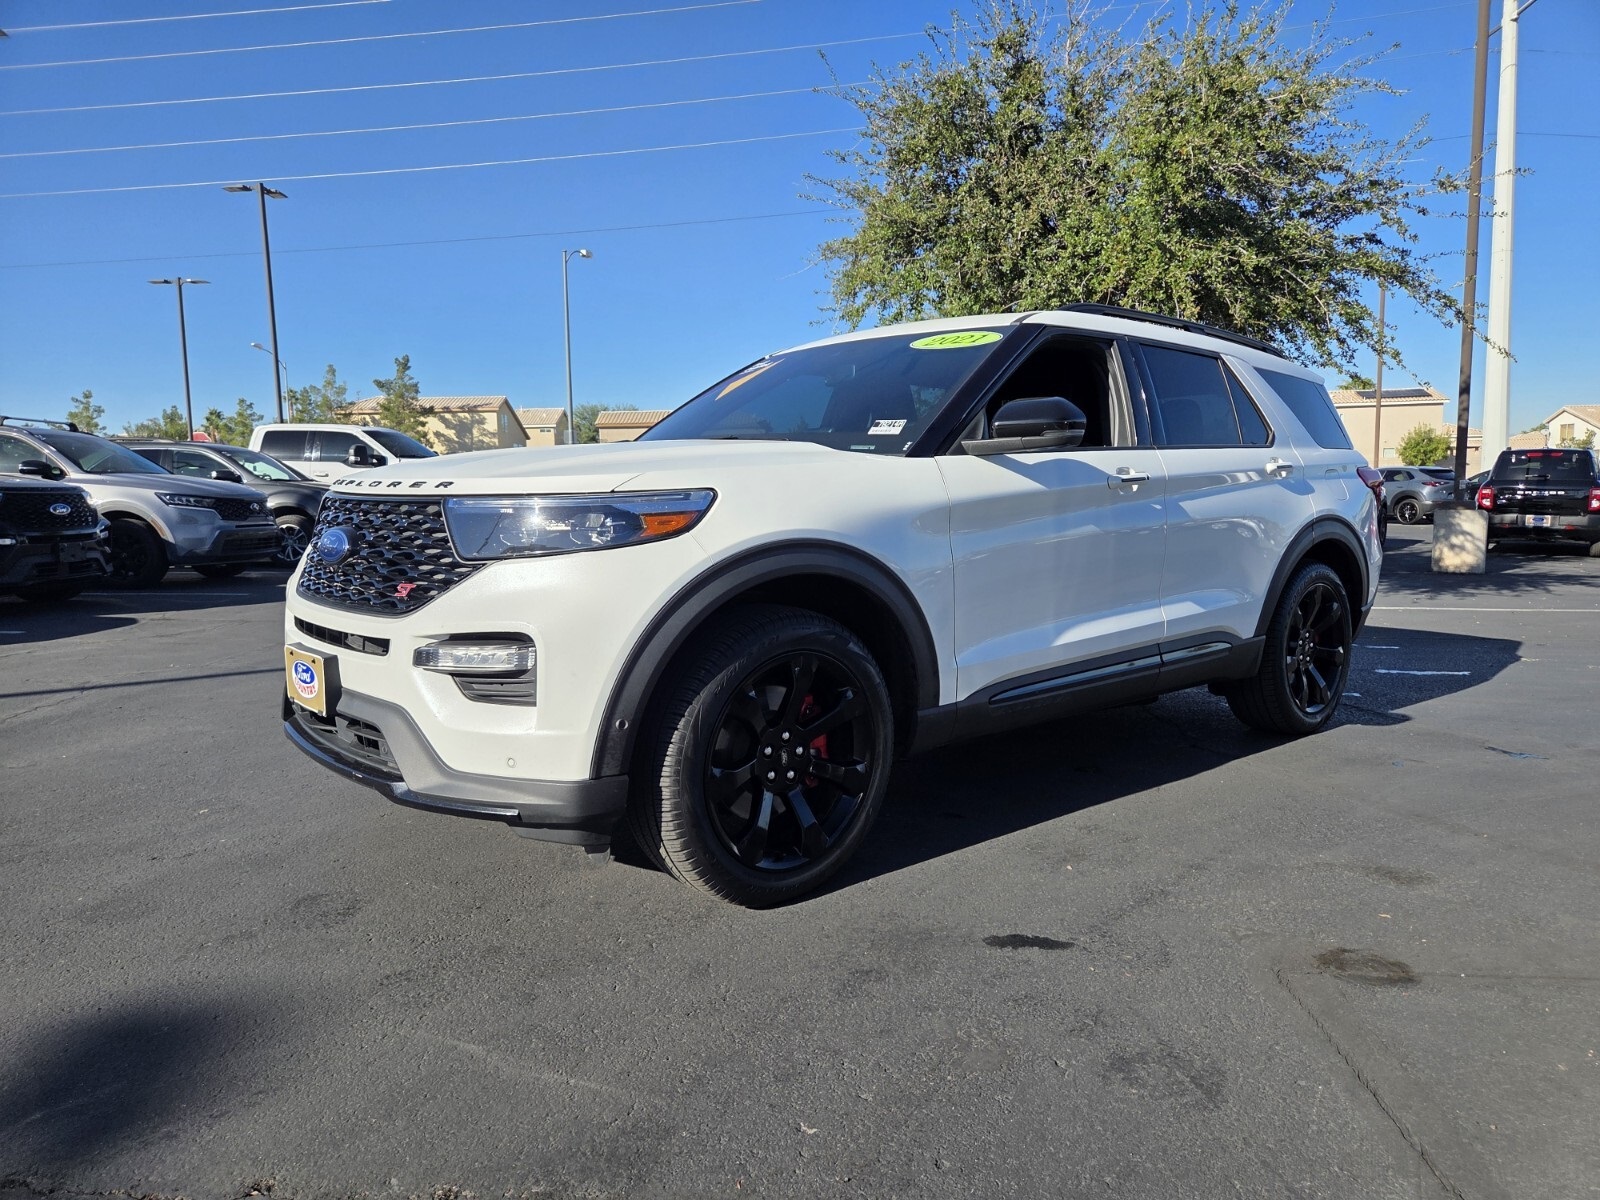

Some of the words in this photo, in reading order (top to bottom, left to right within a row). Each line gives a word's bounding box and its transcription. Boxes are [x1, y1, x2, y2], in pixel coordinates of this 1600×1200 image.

[921, 334, 990, 347] 2021
[332, 479, 455, 488] EXPLORER
[394, 583, 417, 597] ST
[296, 663, 312, 682] Ford
